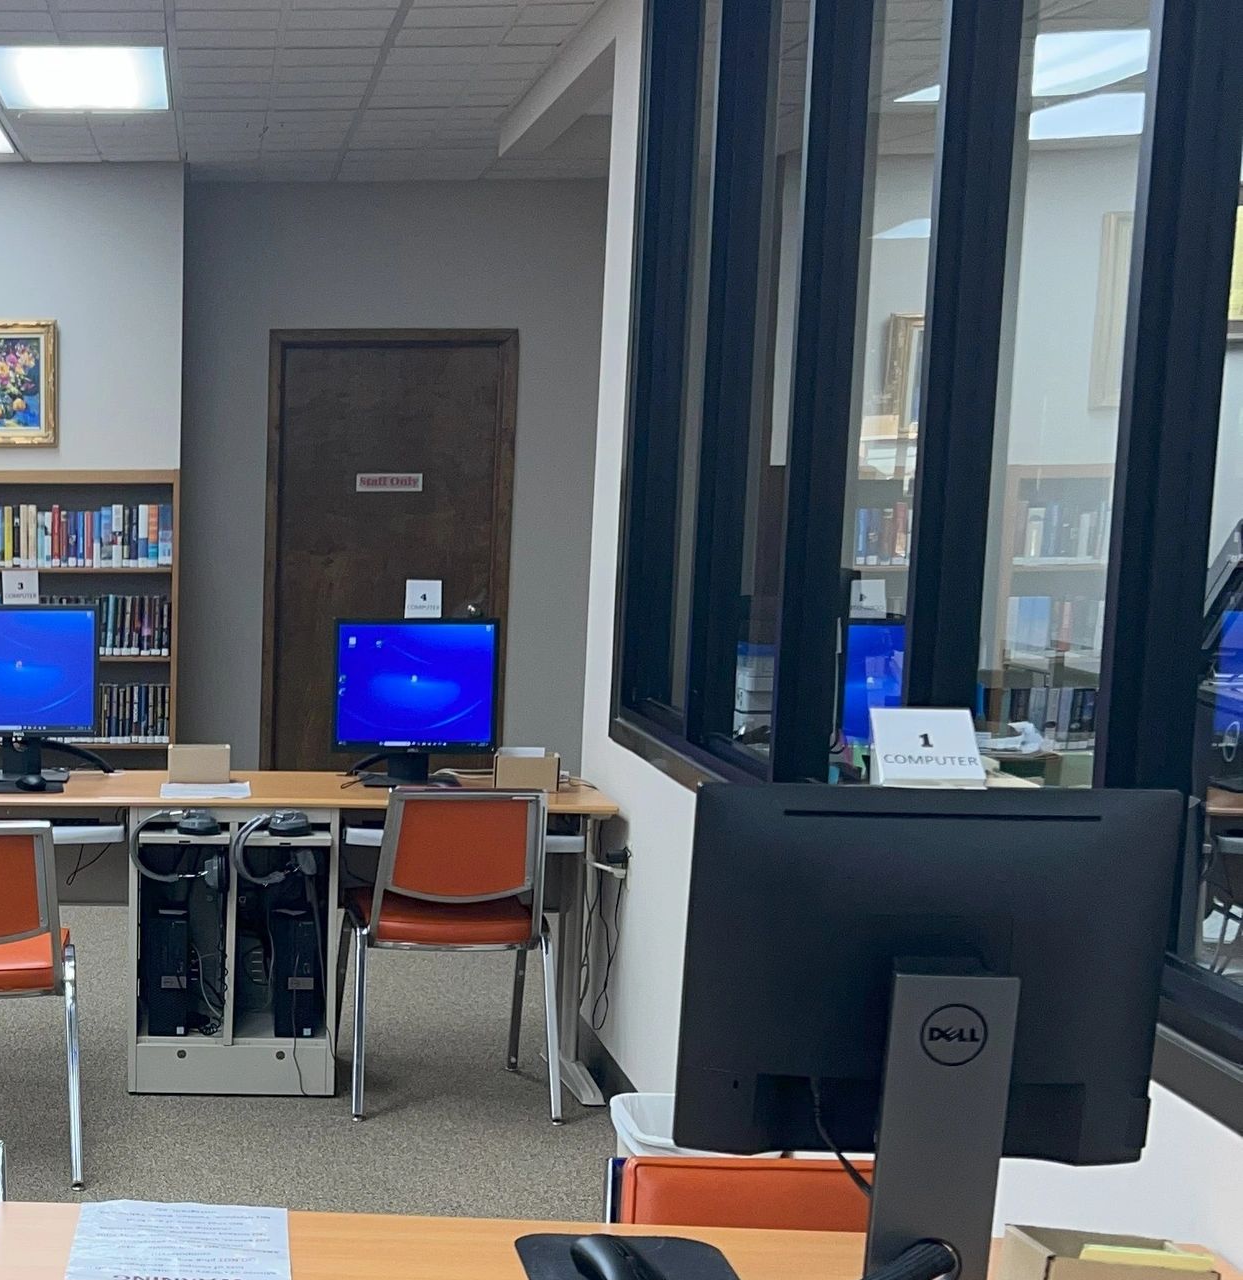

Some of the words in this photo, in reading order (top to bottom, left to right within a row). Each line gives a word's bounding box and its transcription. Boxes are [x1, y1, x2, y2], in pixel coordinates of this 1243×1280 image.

[360, 476, 388, 487] Staff
[389, 476, 418, 489] Only
[17, 582, 24, 590] 3
[420, 593, 427, 601] 4
[918, 733, 934, 748] 1
[883, 754, 979, 766] COMPUTER
[928, 1026, 980, 1043] DELL
